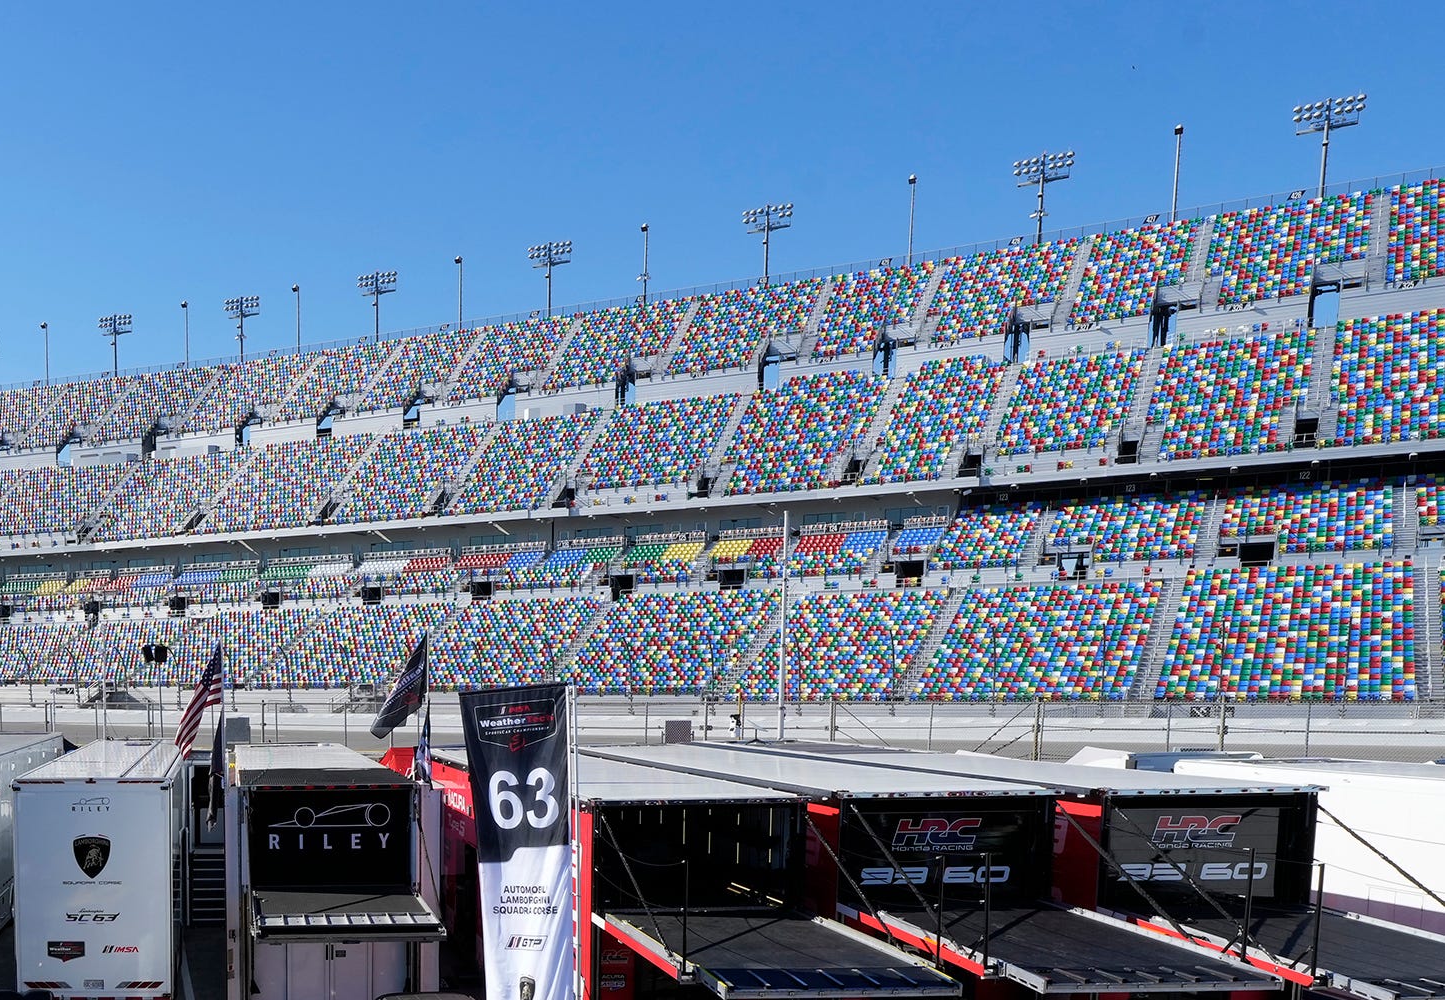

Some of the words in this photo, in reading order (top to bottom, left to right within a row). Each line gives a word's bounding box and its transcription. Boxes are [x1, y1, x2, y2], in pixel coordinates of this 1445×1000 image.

[479, 714, 554, 728] WeatherTech
[489, 767, 559, 829] 63
[892, 818, 983, 846] HRC
[1151, 815, 1242, 843] HRC
[268, 832, 390, 850] RILEY
[942, 865, 1011, 884] 60
[1199, 862, 1268, 880] 60
[521, 938, 544, 948] GTP
